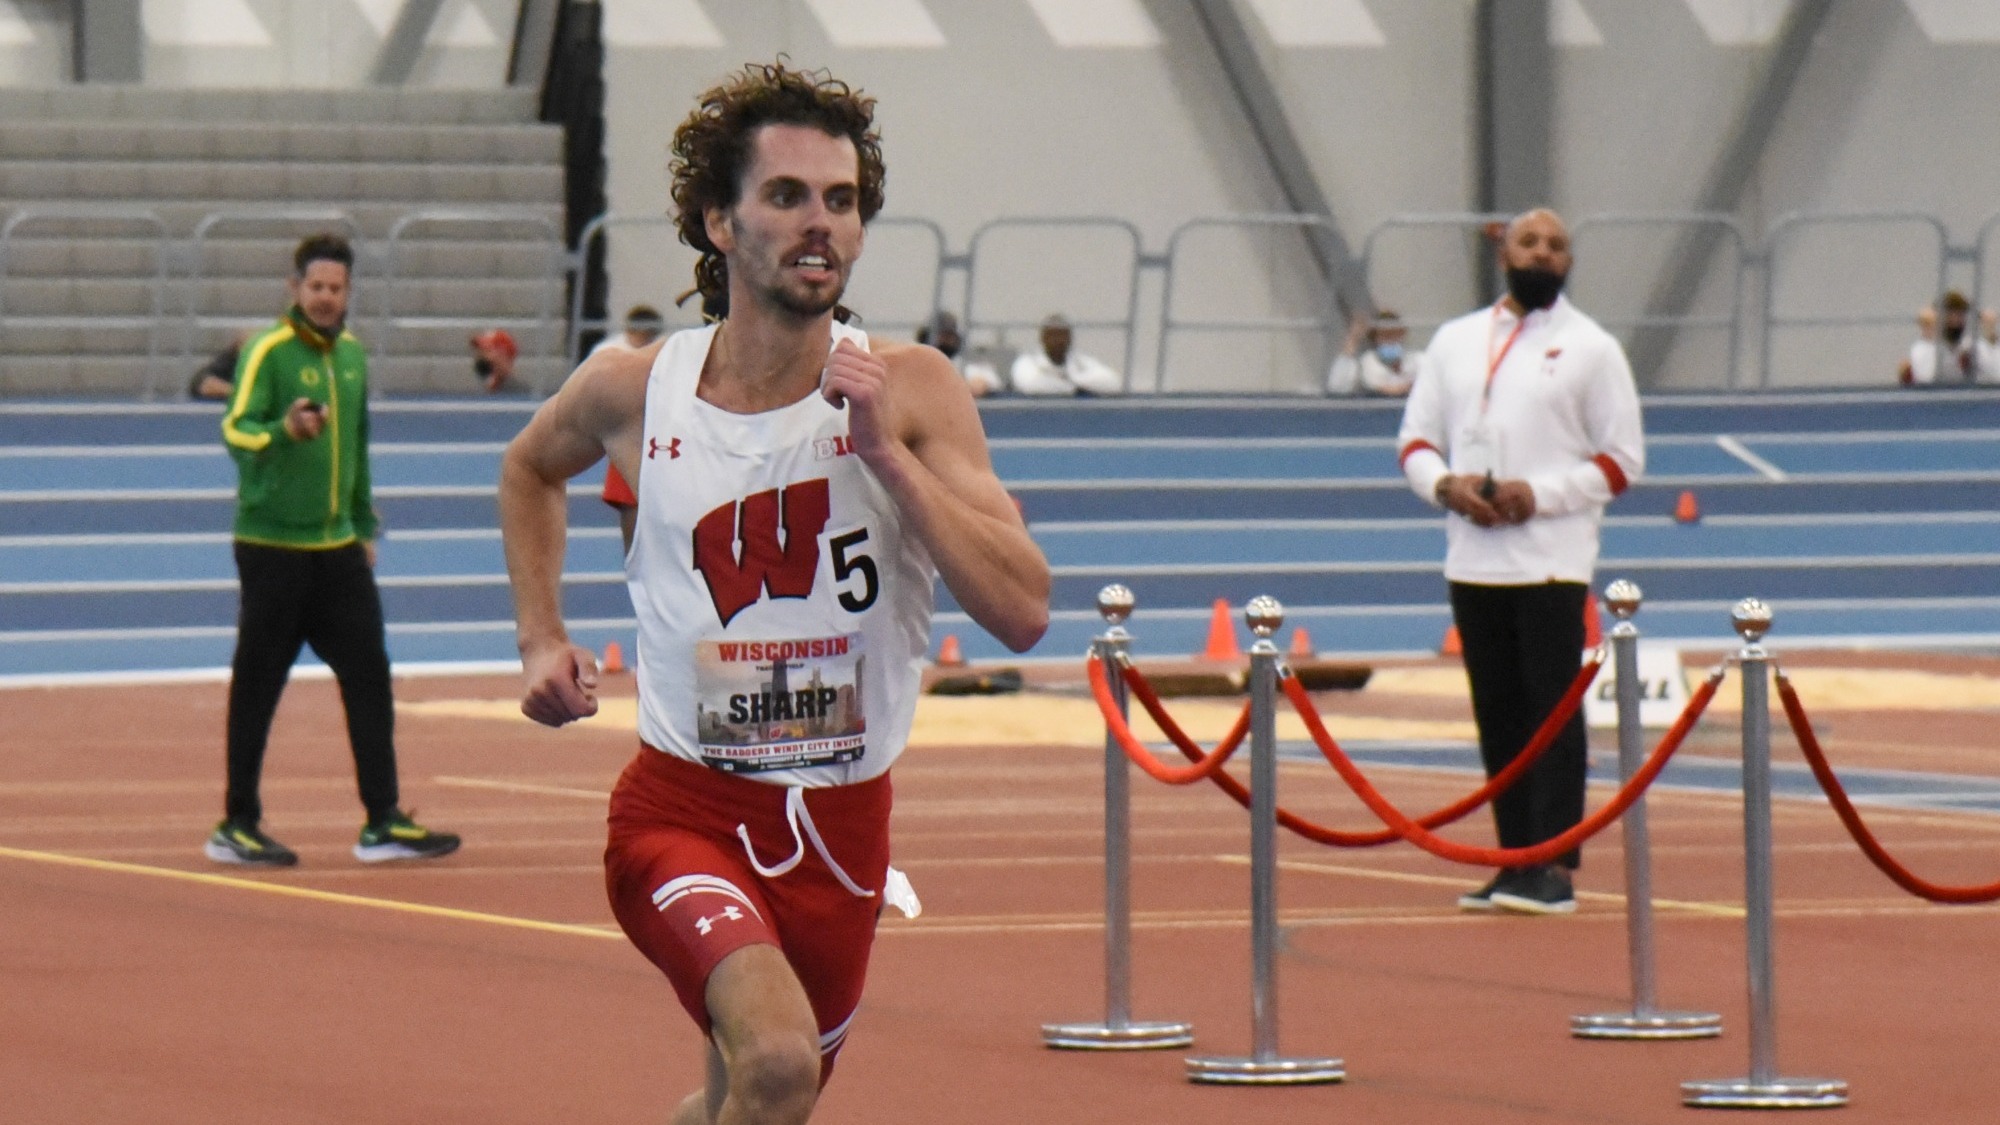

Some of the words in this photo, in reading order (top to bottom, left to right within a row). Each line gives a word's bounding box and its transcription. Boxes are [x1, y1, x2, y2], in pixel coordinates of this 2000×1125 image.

[693, 478, 830, 628] W
[830, 527, 878, 613] 5
[718, 637, 848, 662] WISCONSIN
[729, 687, 837, 724] SHARP
[704, 747, 722, 755] THE
[773, 744, 804, 754] WINDY
[807, 741, 829, 750] CITY
[833, 737, 863, 748] INVITE
